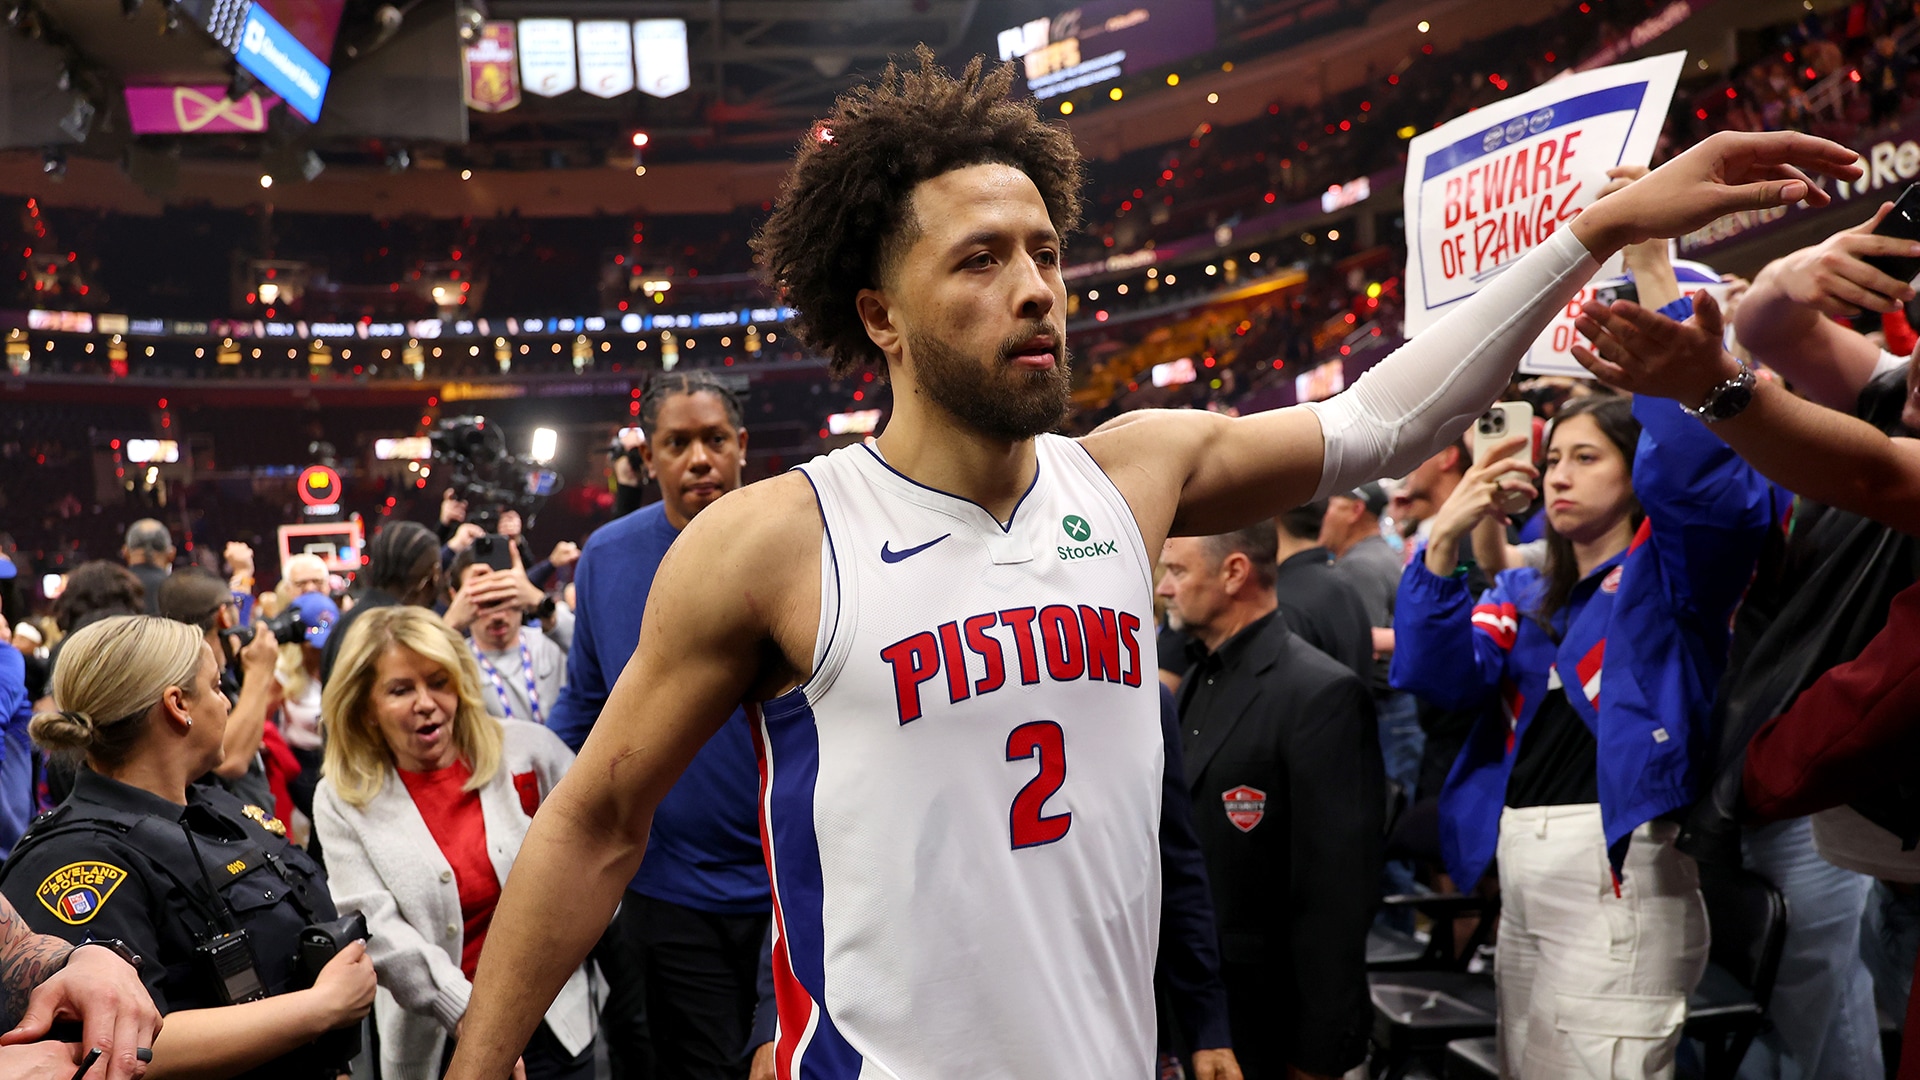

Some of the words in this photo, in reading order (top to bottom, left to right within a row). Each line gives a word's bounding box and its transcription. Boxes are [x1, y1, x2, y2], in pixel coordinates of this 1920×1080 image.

[1444, 130, 1583, 230] BEWARE
[1441, 233, 1466, 279] OF
[1474, 181, 1584, 273] DAWGS
[1057, 540, 1119, 560] StockX
[880, 604, 1142, 726] PISTONS
[1006, 720, 1072, 850] 2
[42, 866, 118, 895] CLEVELAND
[51, 875, 105, 896] POLICE
